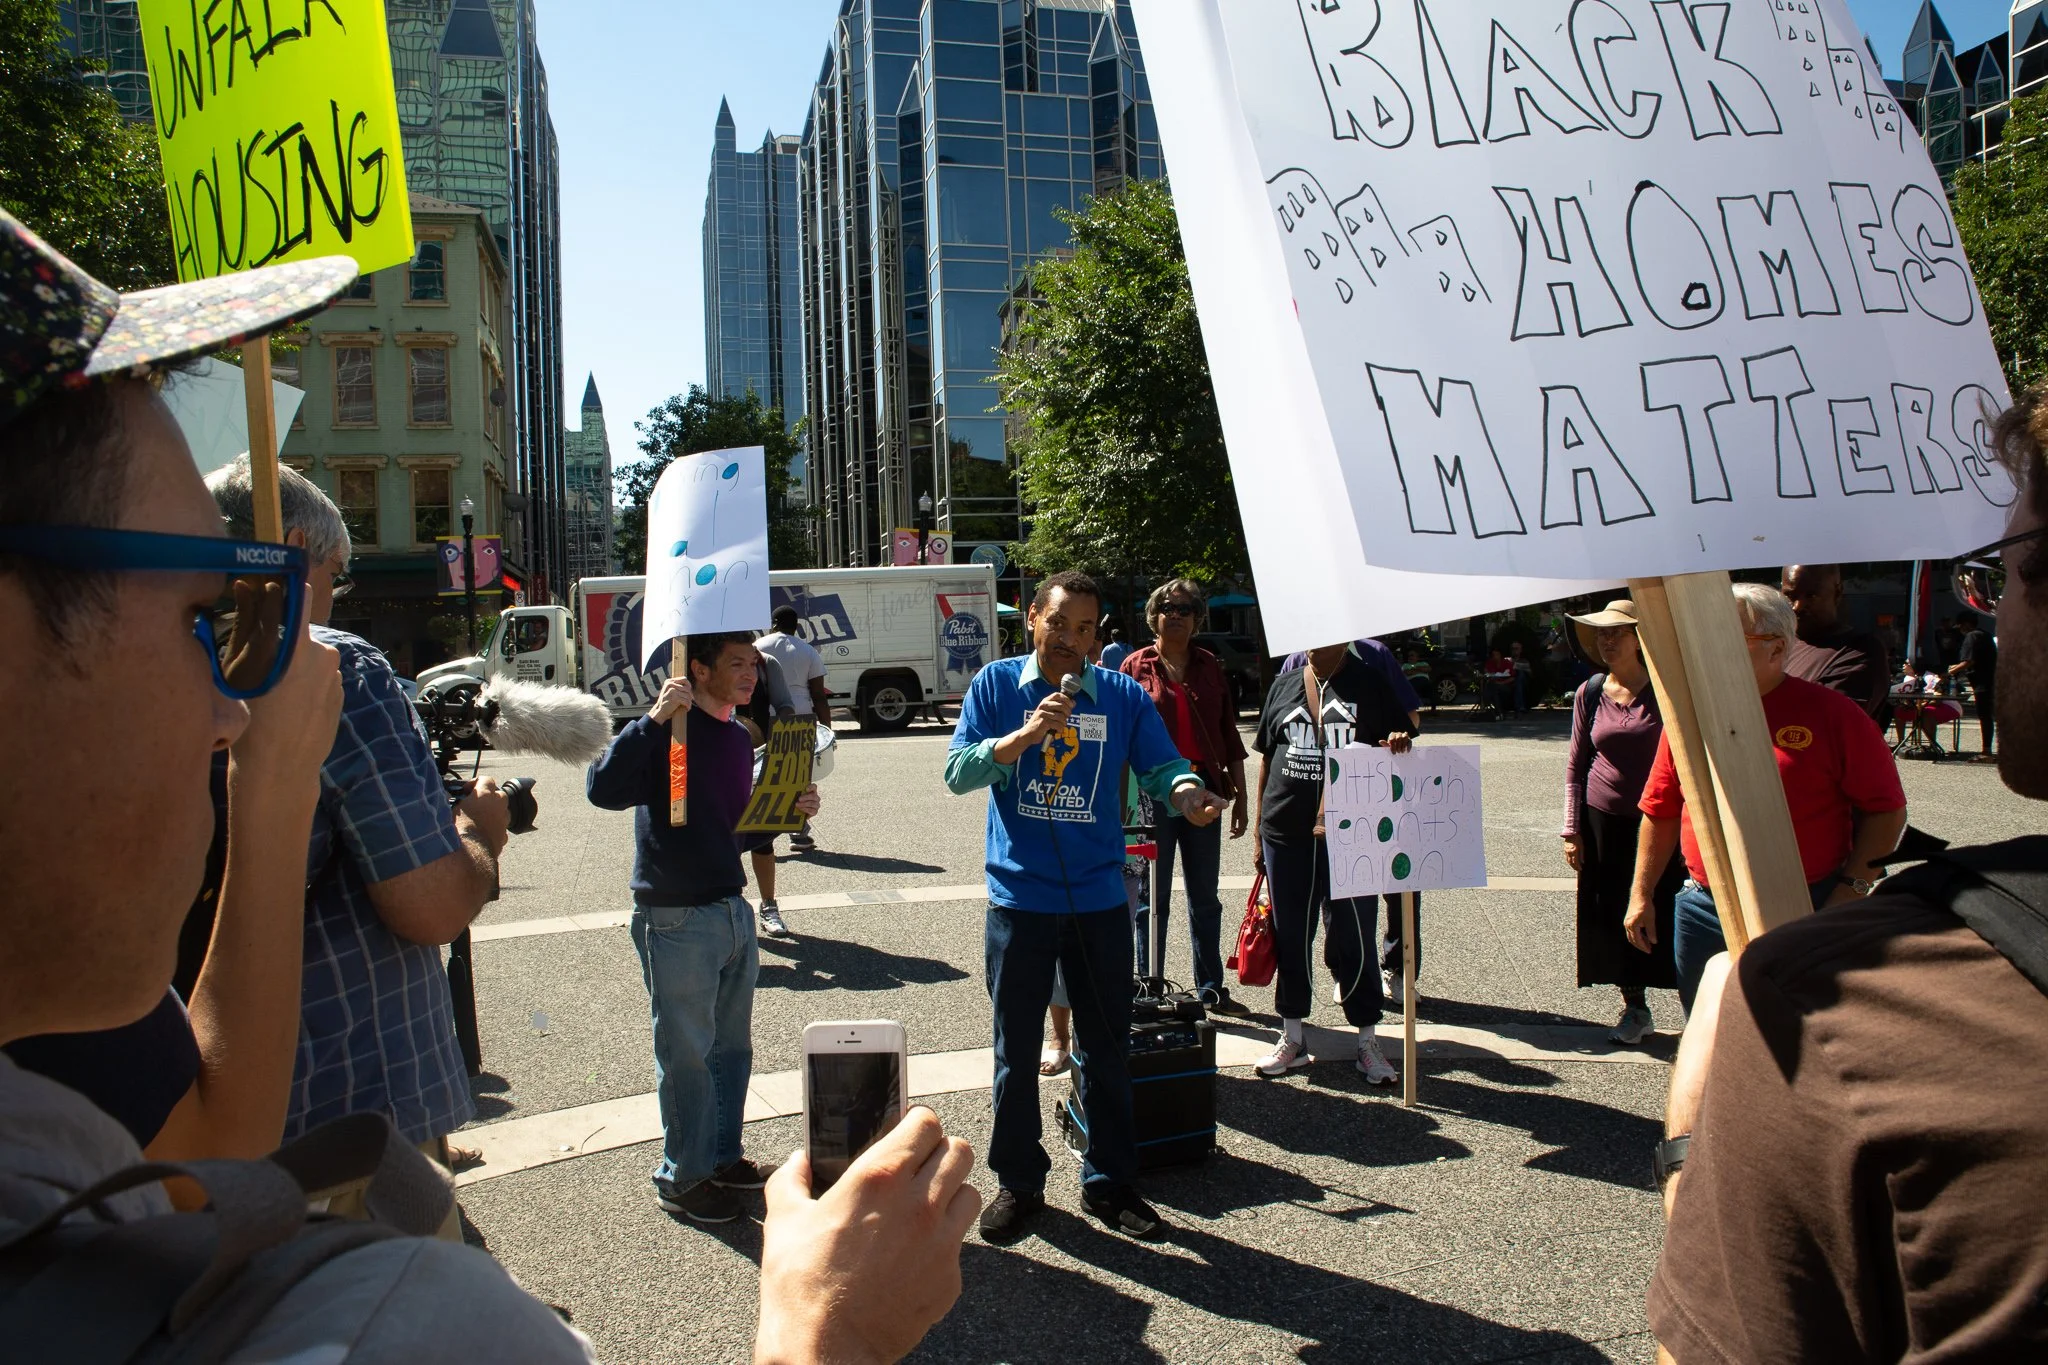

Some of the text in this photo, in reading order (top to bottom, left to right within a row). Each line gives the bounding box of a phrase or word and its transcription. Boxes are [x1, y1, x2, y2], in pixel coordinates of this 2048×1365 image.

[168, 99, 389, 284] HOUSING
[1492, 180, 1975, 342] HOMES
[1365, 346, 2020, 539] MATTERS
[235, 546, 289, 565] Nectar
[940, 634, 988, 647] Blue Ribbon
[948, 619, 977, 635] Pabst
[596, 661, 673, 707] Blu
[1081, 716, 1105, 724] HOMES
[770, 728, 814, 755] HOMES
[762, 750, 811, 787] FOR
[1281, 768, 1324, 781] TO SAVE OU
[1287, 760, 1322, 772] TENANTS
[742, 790, 803, 825] ALL
